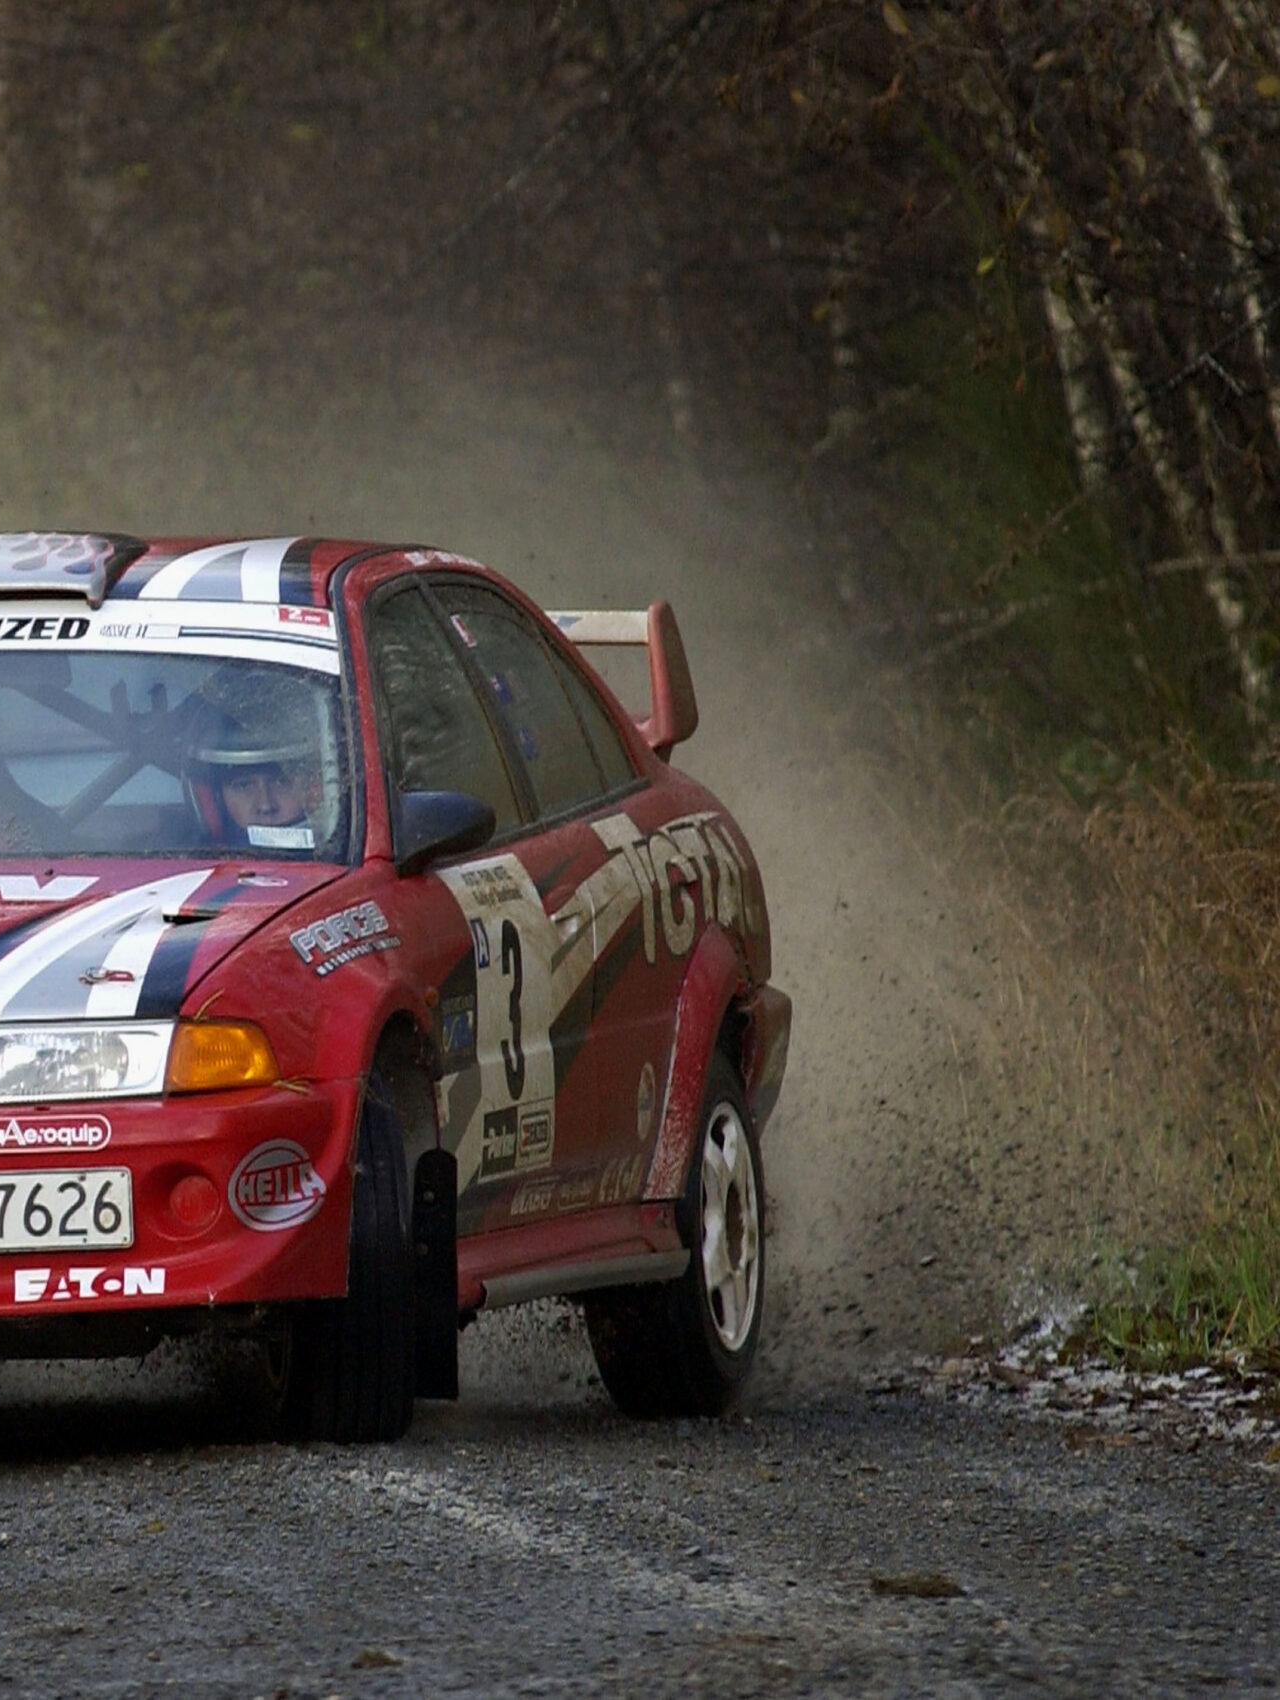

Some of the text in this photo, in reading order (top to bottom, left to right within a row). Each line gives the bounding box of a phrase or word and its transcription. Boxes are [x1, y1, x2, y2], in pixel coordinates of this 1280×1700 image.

[500, 918, 525, 1100] 3
[2, 1117, 104, 1149] Aeroquip
[237, 1163, 327, 1204] HELLA
[14, 1268, 165, 1302] EATON
